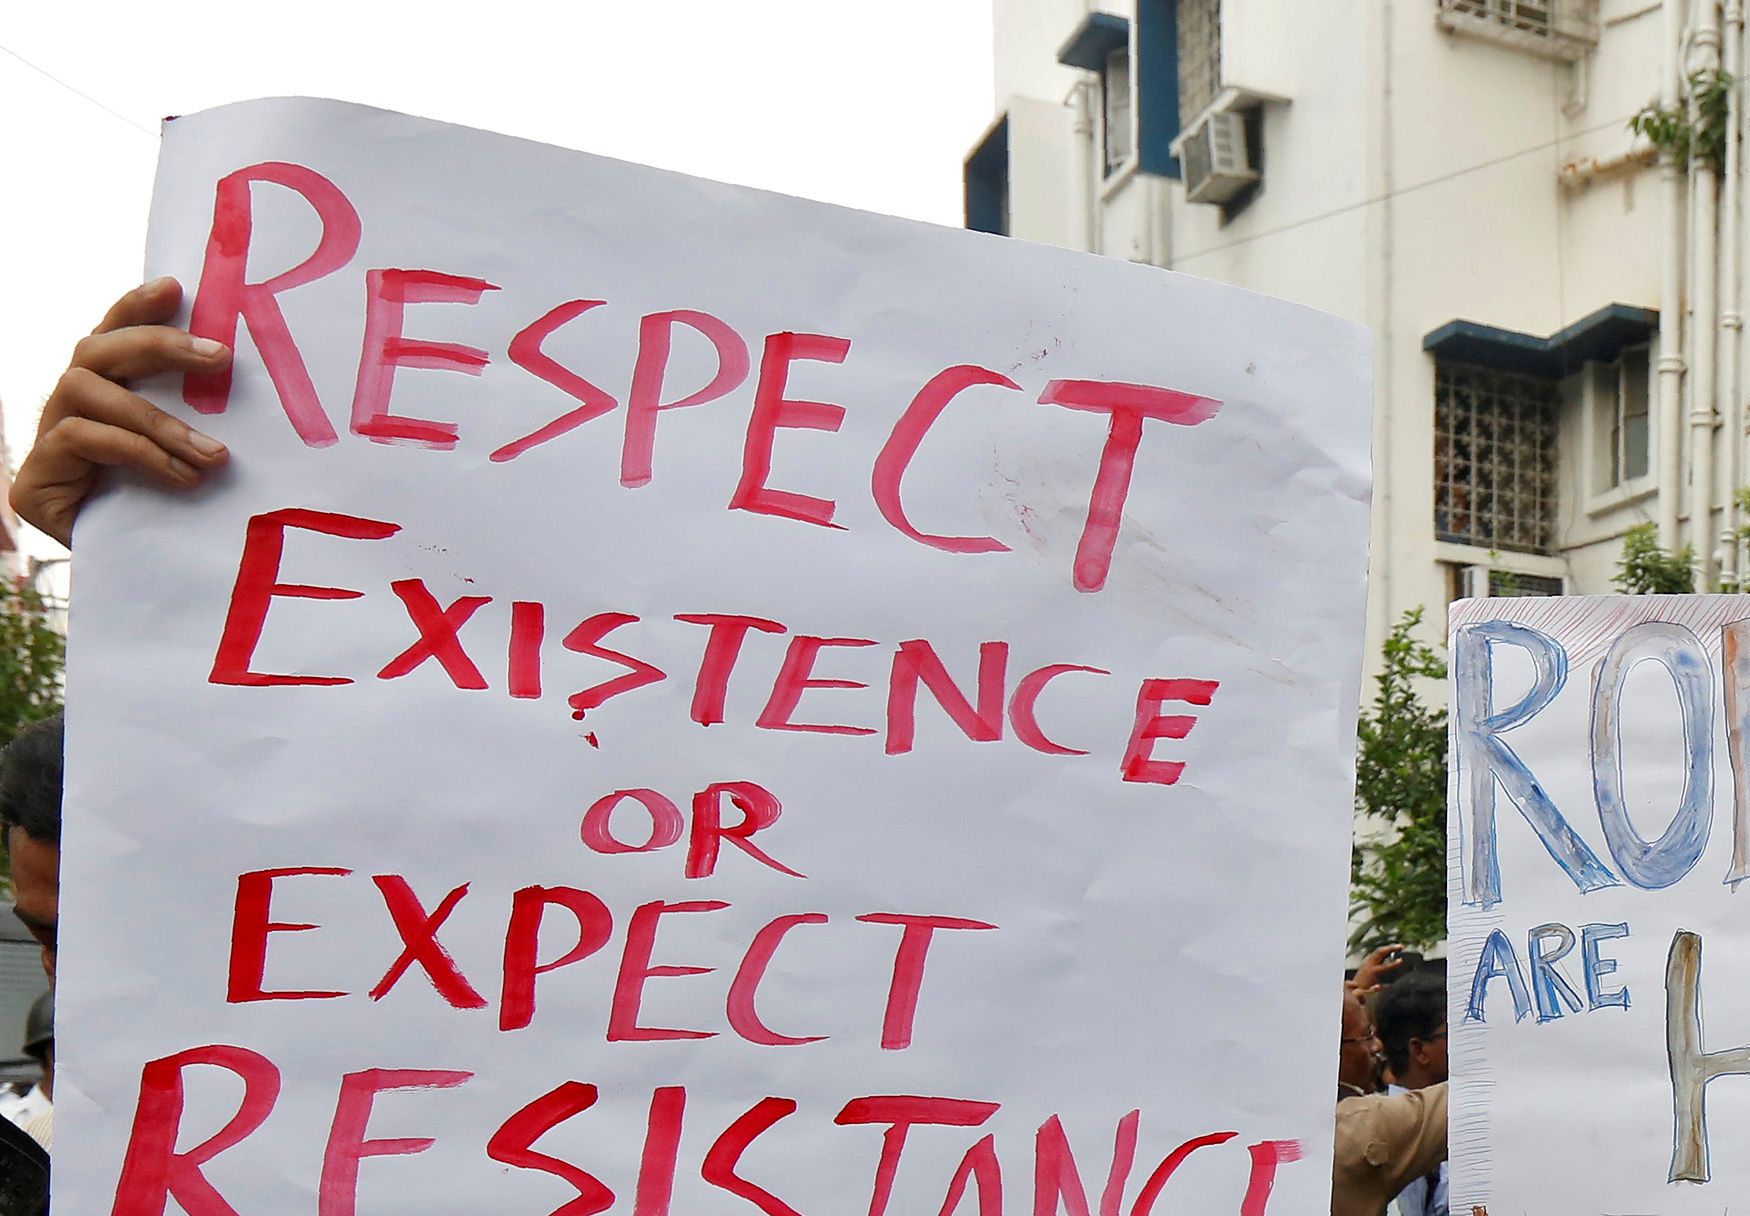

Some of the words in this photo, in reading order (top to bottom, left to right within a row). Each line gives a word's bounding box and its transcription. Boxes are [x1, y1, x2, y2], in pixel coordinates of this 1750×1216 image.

[183, 162, 1224, 593] RESPECT
[208, 508, 1220, 786] EXISTENCE
[581, 781, 806, 879] OR
[227, 867, 1000, 1050] EXPECT
[1462, 921, 1631, 1024] ARE
